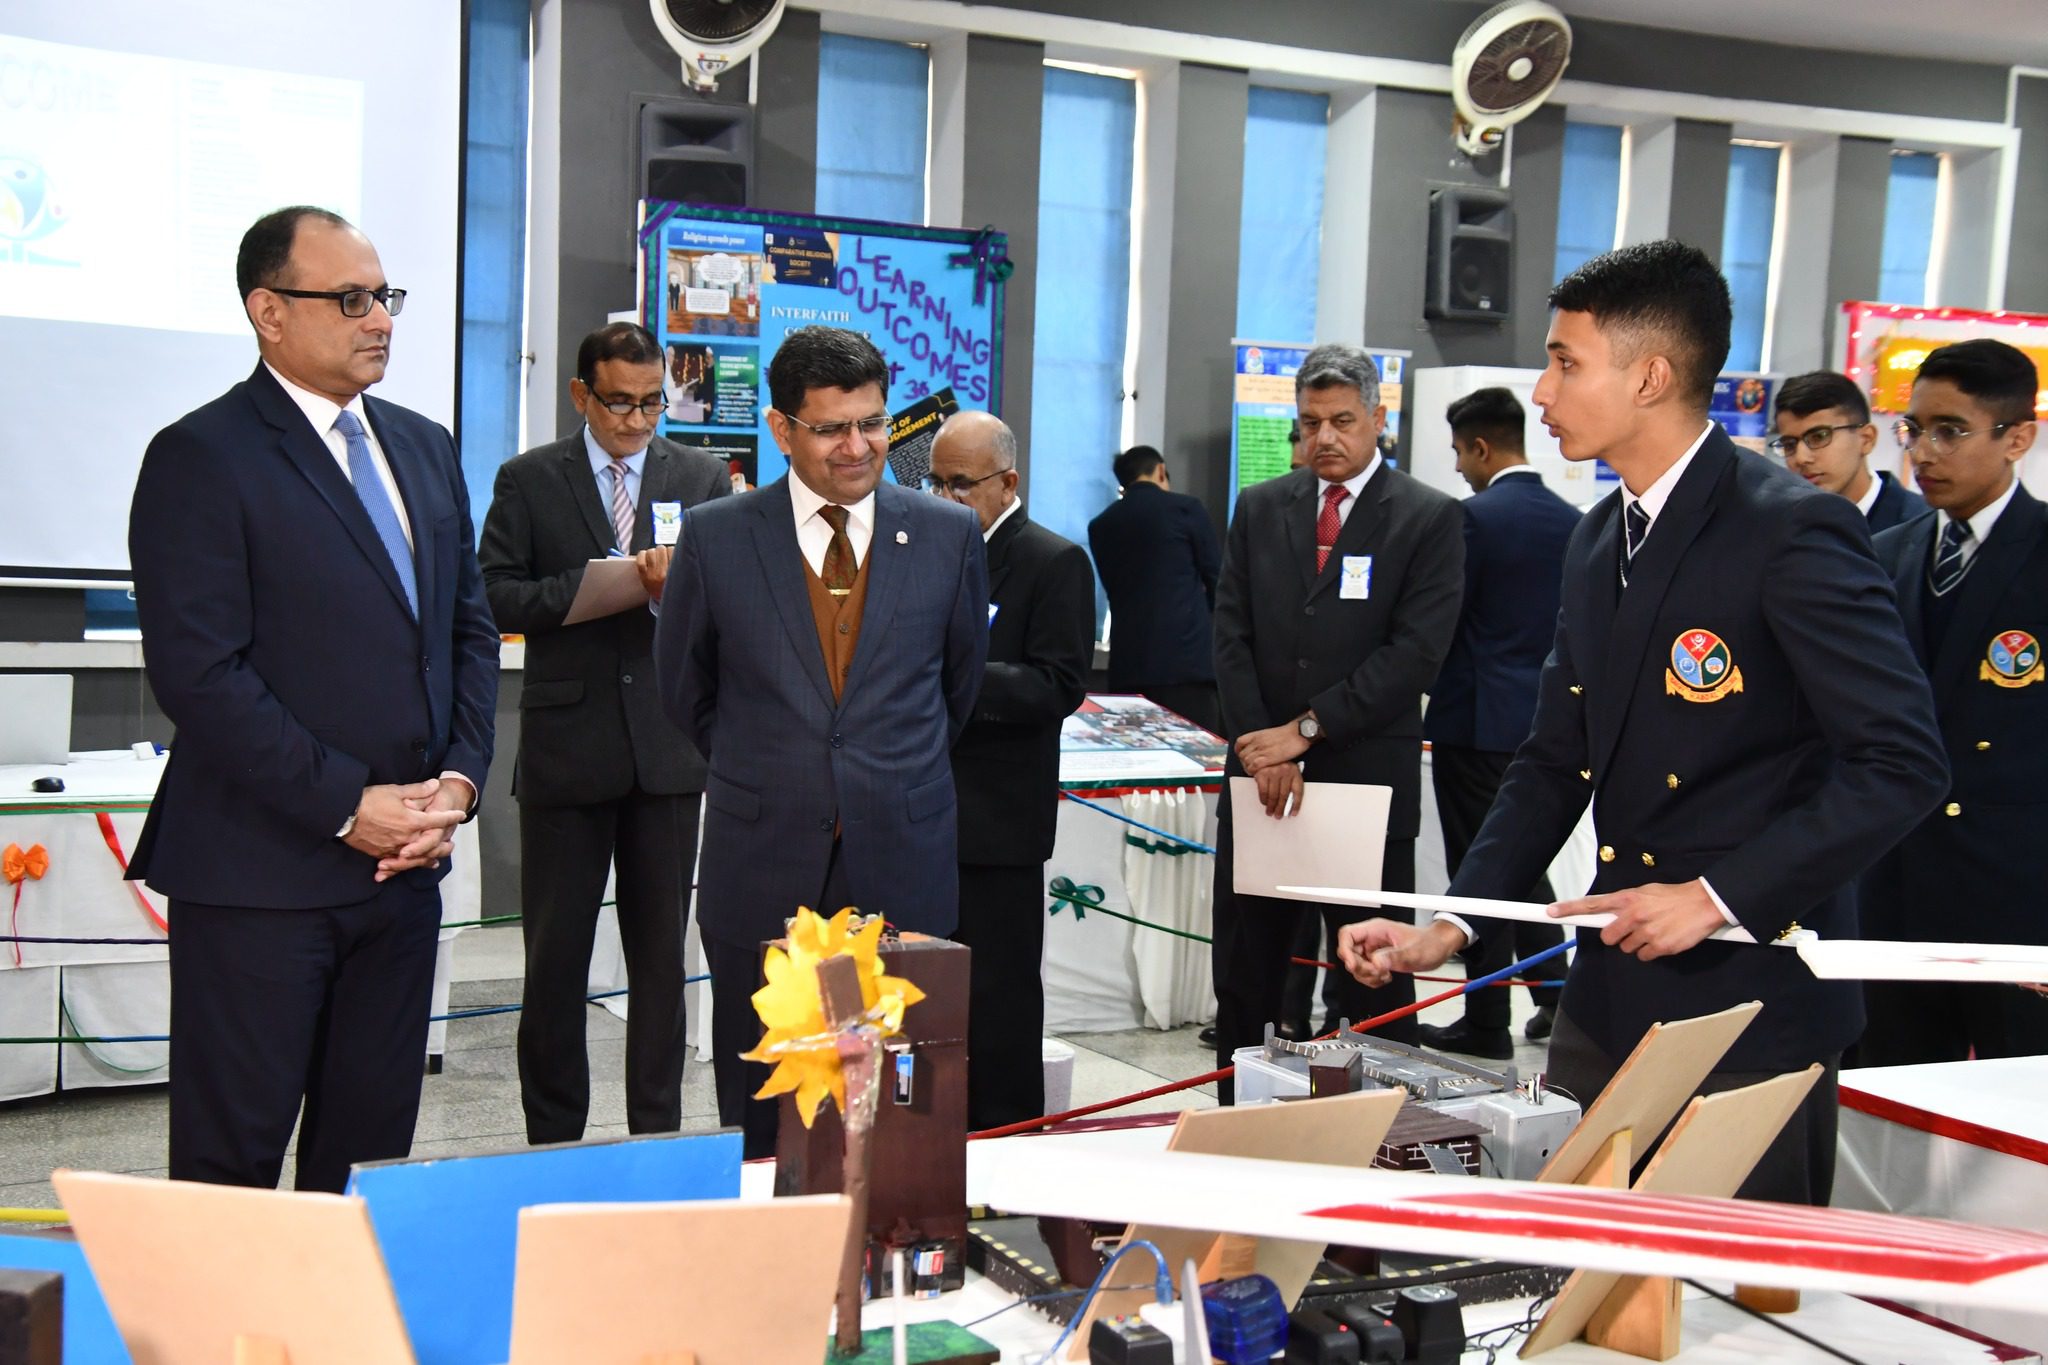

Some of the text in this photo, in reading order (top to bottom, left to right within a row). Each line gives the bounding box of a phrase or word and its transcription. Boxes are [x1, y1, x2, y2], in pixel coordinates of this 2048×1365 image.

[771, 305, 850, 323] INTERFAITH
[837, 266, 988, 402] OUTCOMES
[856, 236, 990, 366] LEARNING
